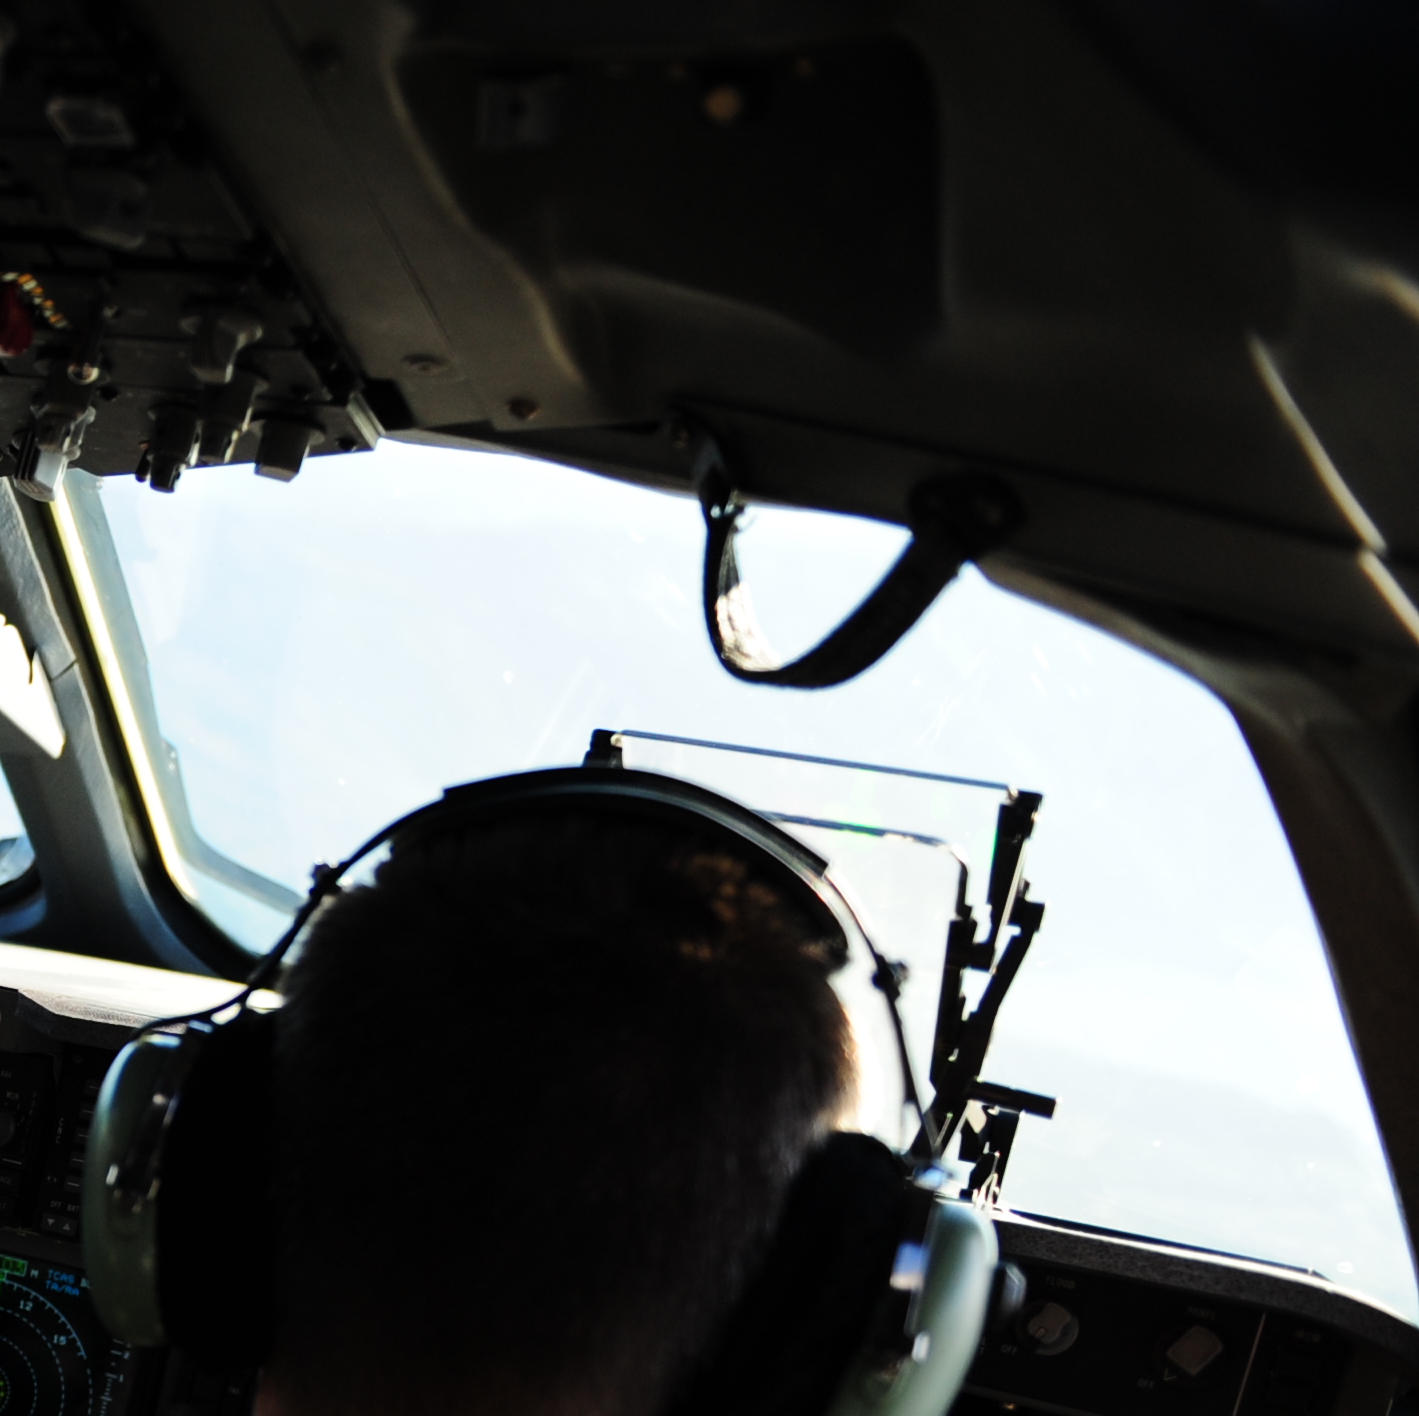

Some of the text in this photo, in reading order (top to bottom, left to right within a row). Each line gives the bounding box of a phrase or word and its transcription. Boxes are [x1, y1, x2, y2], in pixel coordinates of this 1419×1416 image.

[48, 1269, 75, 1284] TCAS
[1045, 1275, 1076, 1290] FLOOD
[46, 1280, 80, 1296] TA/RA
[19, 1300, 33, 1312] 12
[1001, 1344, 1018, 1355] OFF
